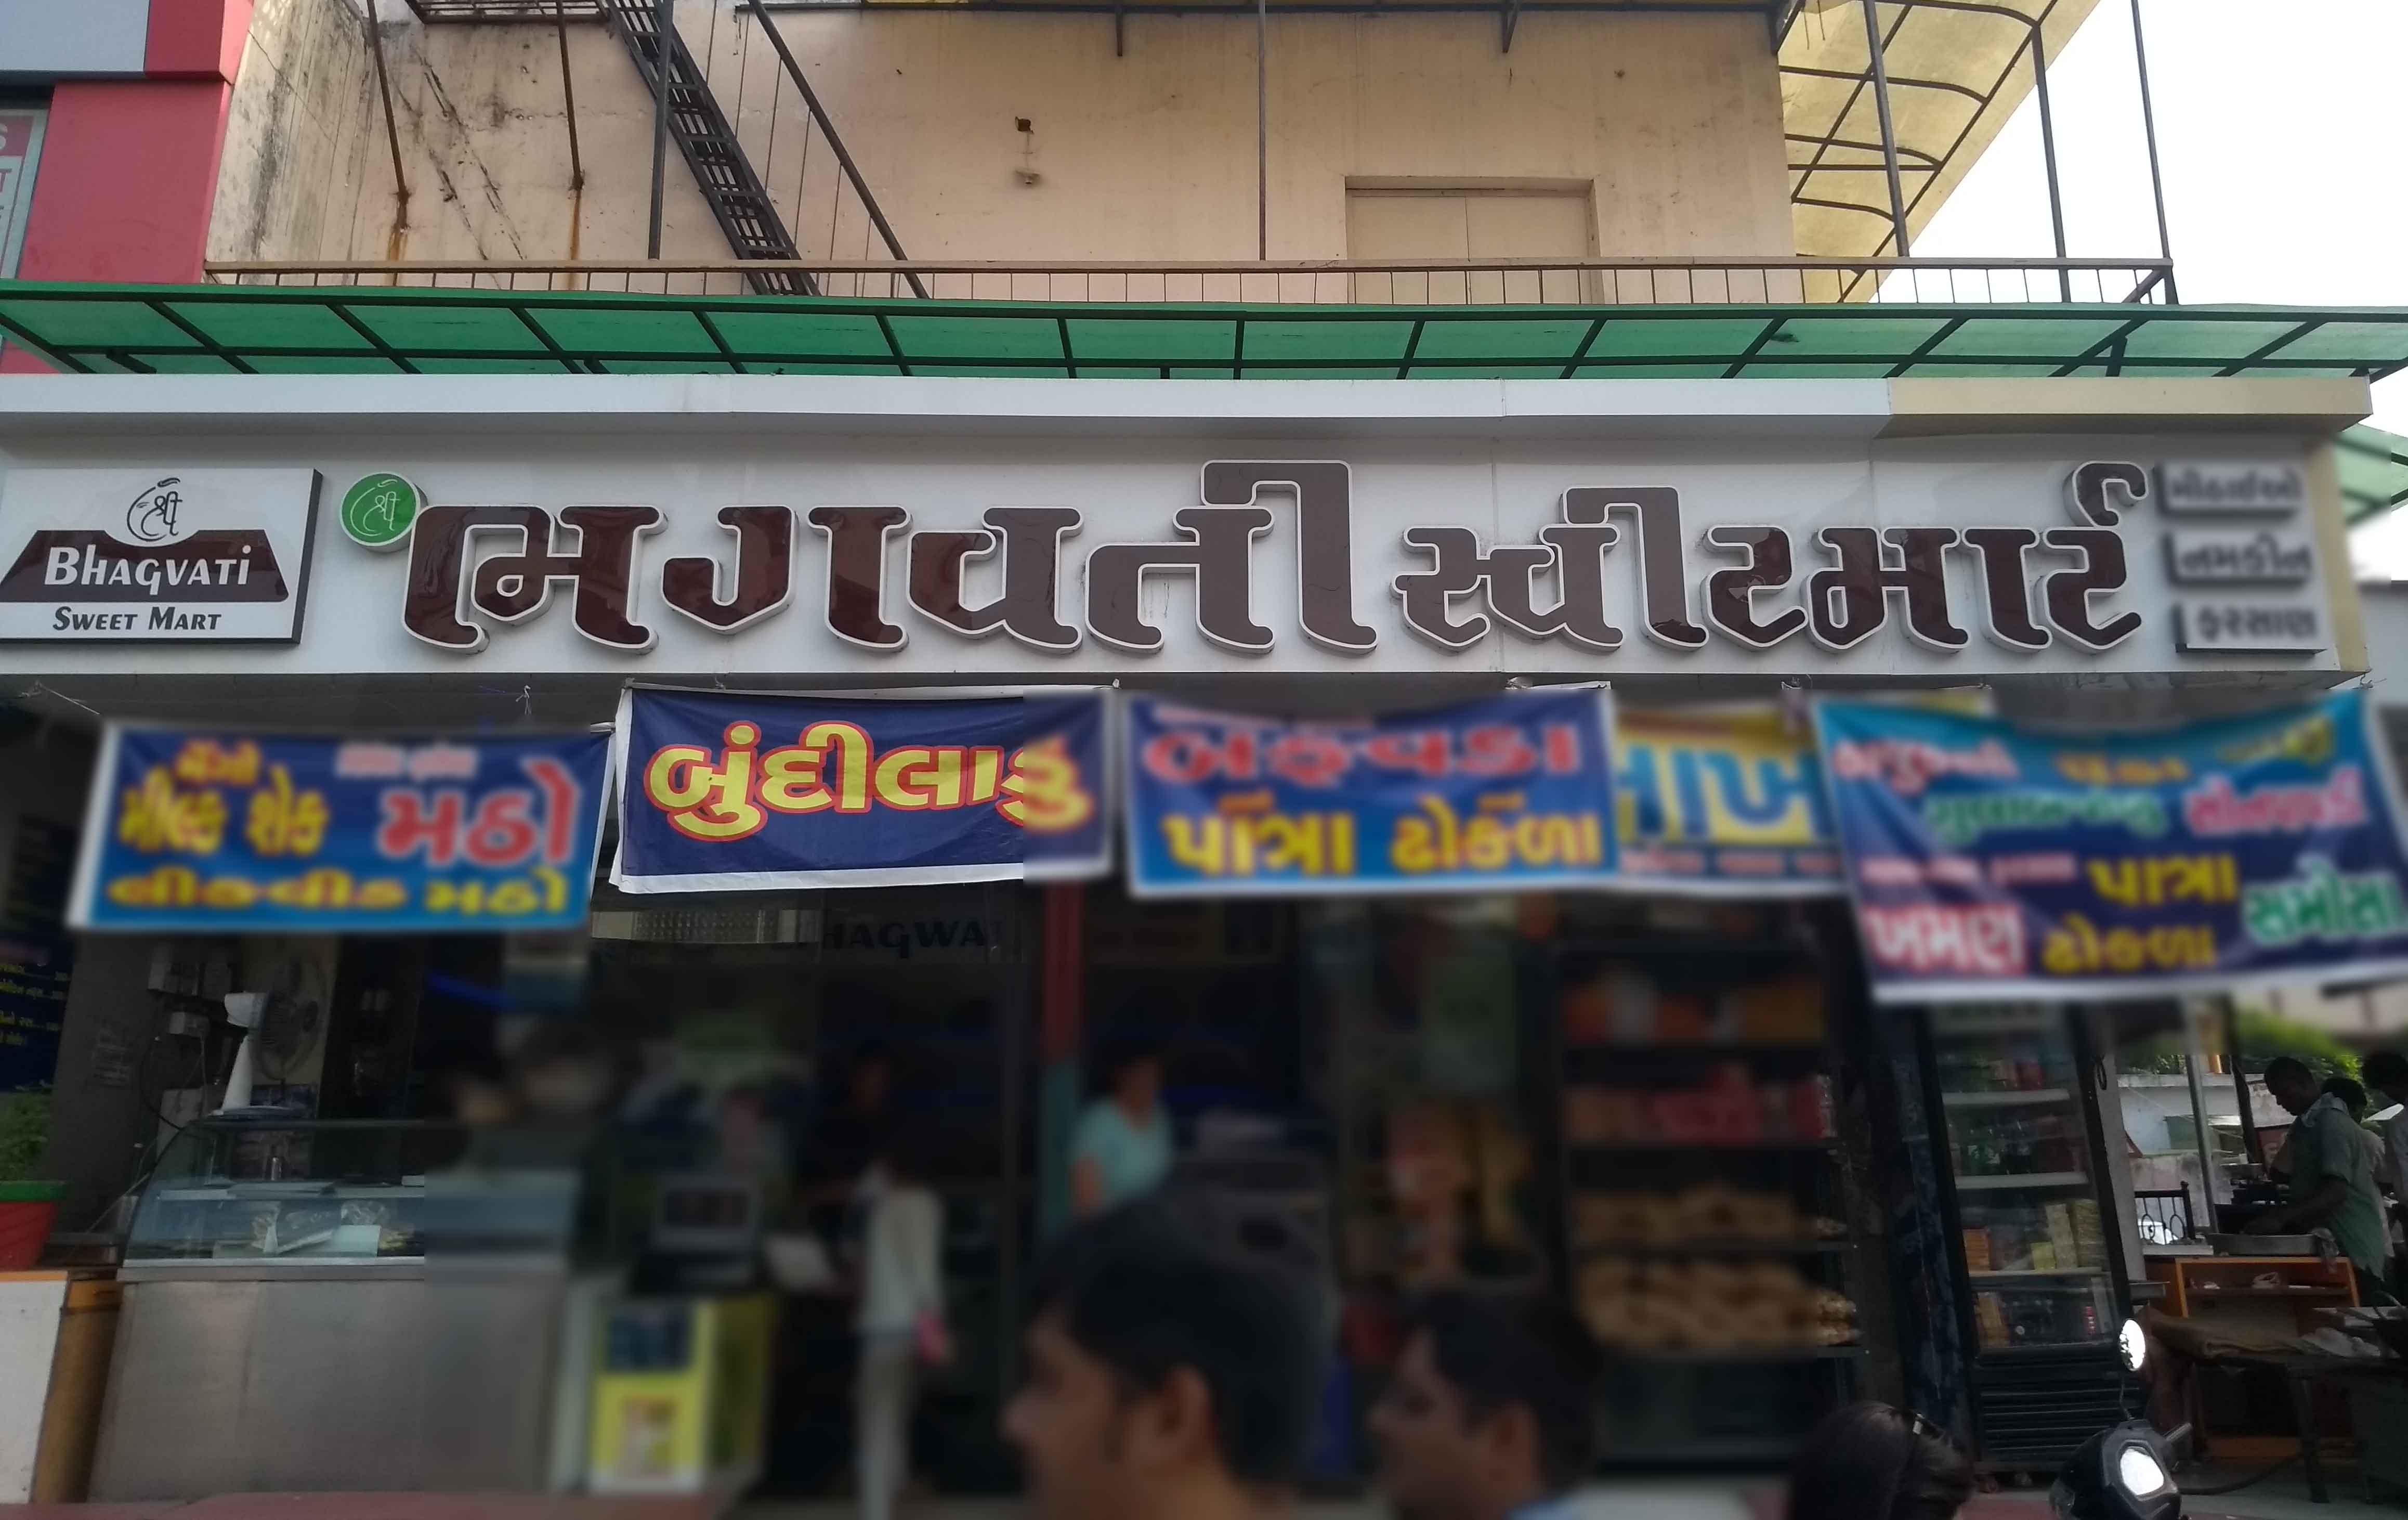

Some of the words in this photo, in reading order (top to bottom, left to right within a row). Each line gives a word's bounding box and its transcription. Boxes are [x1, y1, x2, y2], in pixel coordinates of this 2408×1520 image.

[403, 460, 1379, 654] ભગવતી
[52, 605, 138, 631] SWEET
[148, 605, 223, 631] MART
